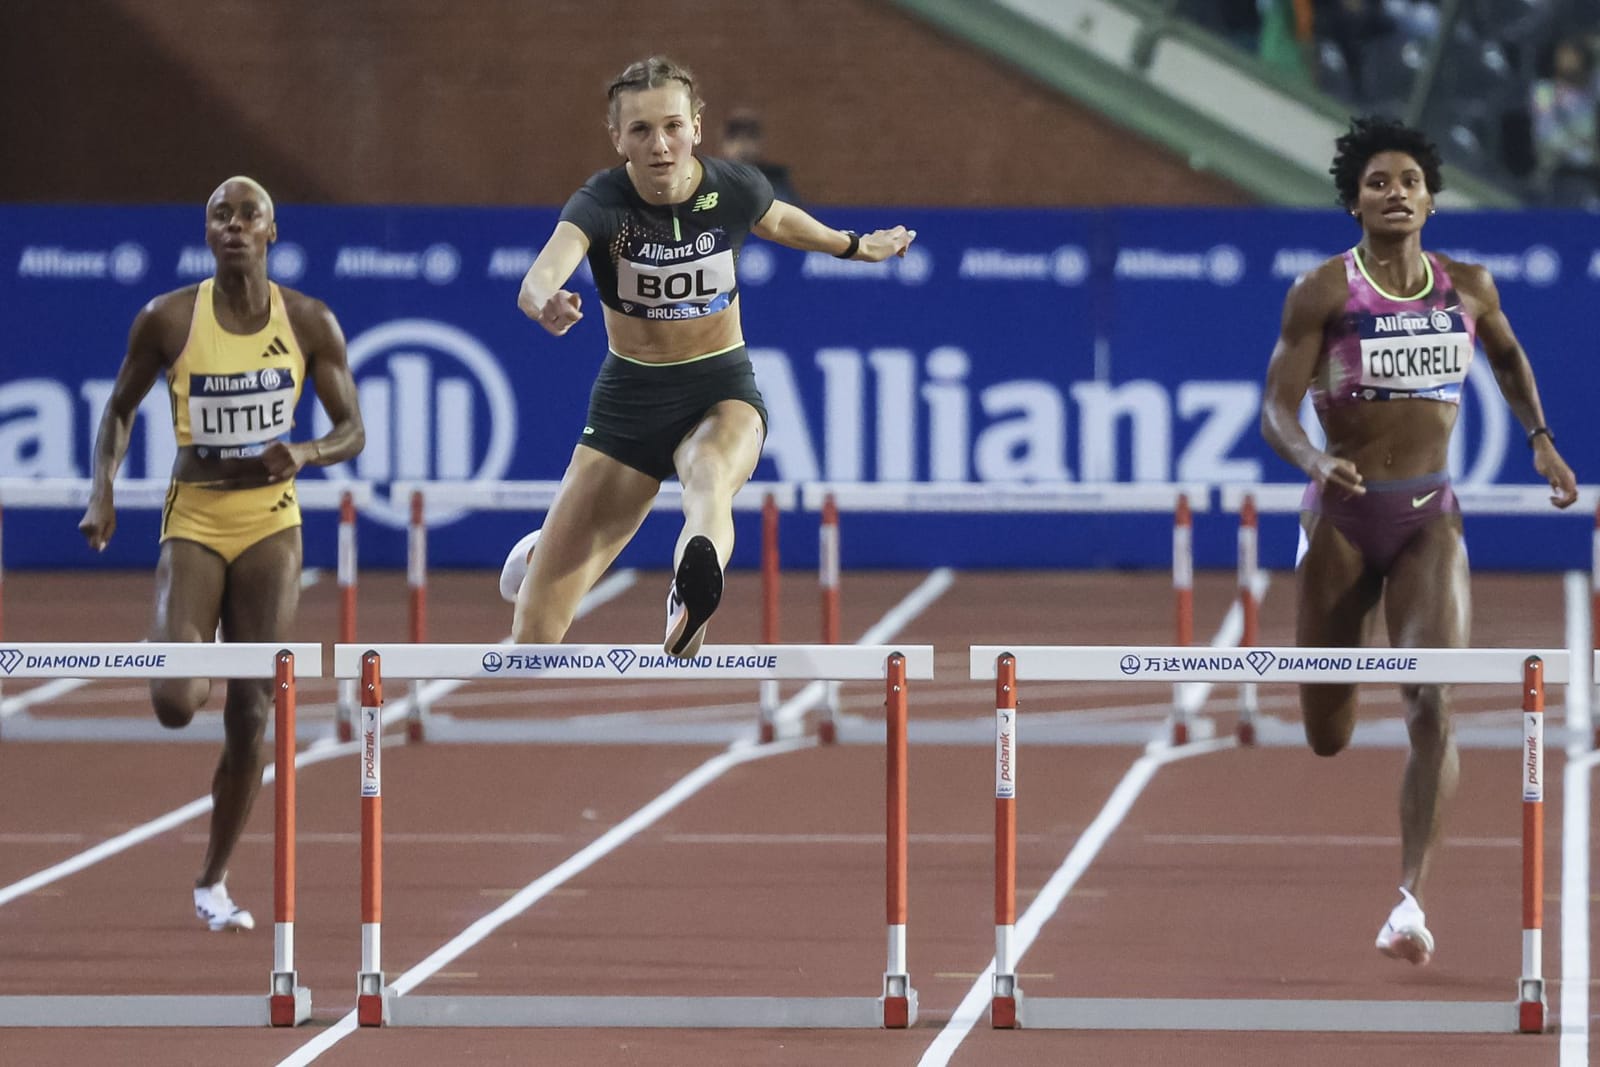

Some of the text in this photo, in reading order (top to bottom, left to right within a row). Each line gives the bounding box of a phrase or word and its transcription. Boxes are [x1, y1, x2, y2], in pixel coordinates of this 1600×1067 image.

[638, 243, 694, 260] Allianz
[637, 269, 718, 299] BOL
[647, 305, 711, 319] BRUSSELS
[1375, 316, 1430, 333] Allianz
[1370, 345, 1462, 378] COCKRELL
[203, 375, 258, 392] Allianz
[202, 399, 284, 434] LITTLE
[26, 654, 166, 668] DIAMOND LEAGUE
[506, 655, 777, 670] 万达 WANDA DIAMOND LEAGUE
[1144, 657, 1418, 672] 万达 WANDA DIAMOND LEAGUE
[364, 730, 376, 779] polanik
[1000, 732, 1012, 782] polanik
[1526, 735, 1539, 785] polanik
